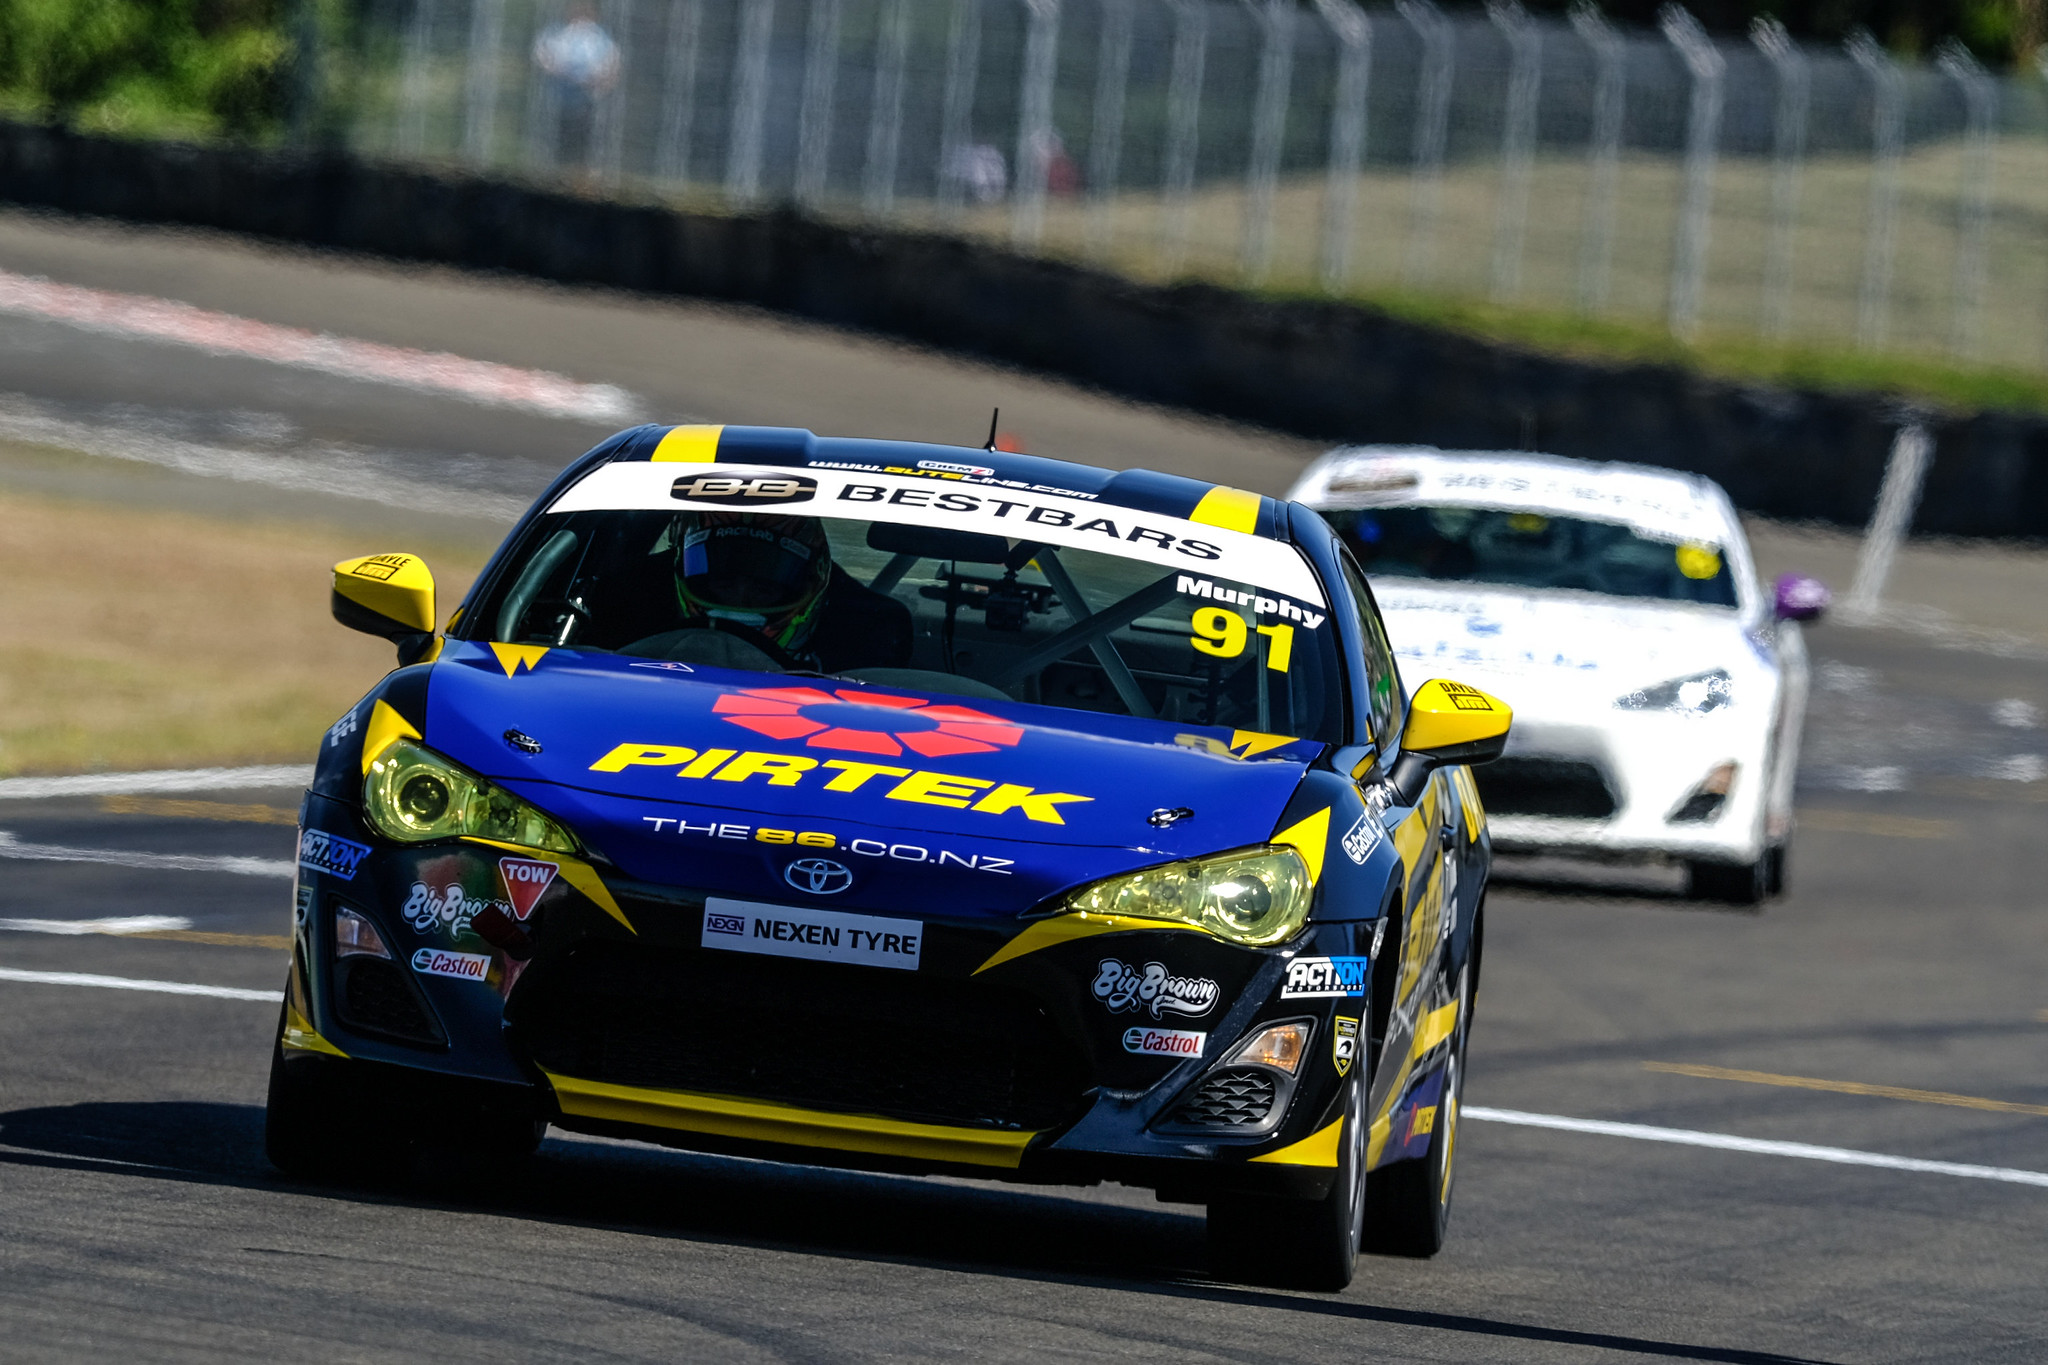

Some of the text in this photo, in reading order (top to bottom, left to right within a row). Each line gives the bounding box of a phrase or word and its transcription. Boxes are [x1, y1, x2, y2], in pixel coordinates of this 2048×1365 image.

[836, 484, 1223, 561] BESTBARS
[1176, 575, 1325, 629] Murphy
[1190, 606, 1294, 673] 91
[588, 743, 1095, 825] PIRTEK
[300, 832, 364, 869] ACTION
[643, 816, 1015, 875] THE86.CO.NZ
[506, 864, 550, 884] TOW
[753, 918, 917, 955] NEXEN TYRE
[431, 953, 486, 977] Castrol
[1287, 962, 1364, 987] ACTION
[1287, 984, 1363, 993] MOTORSPORT
[1142, 1031, 1200, 1054] Castrol
